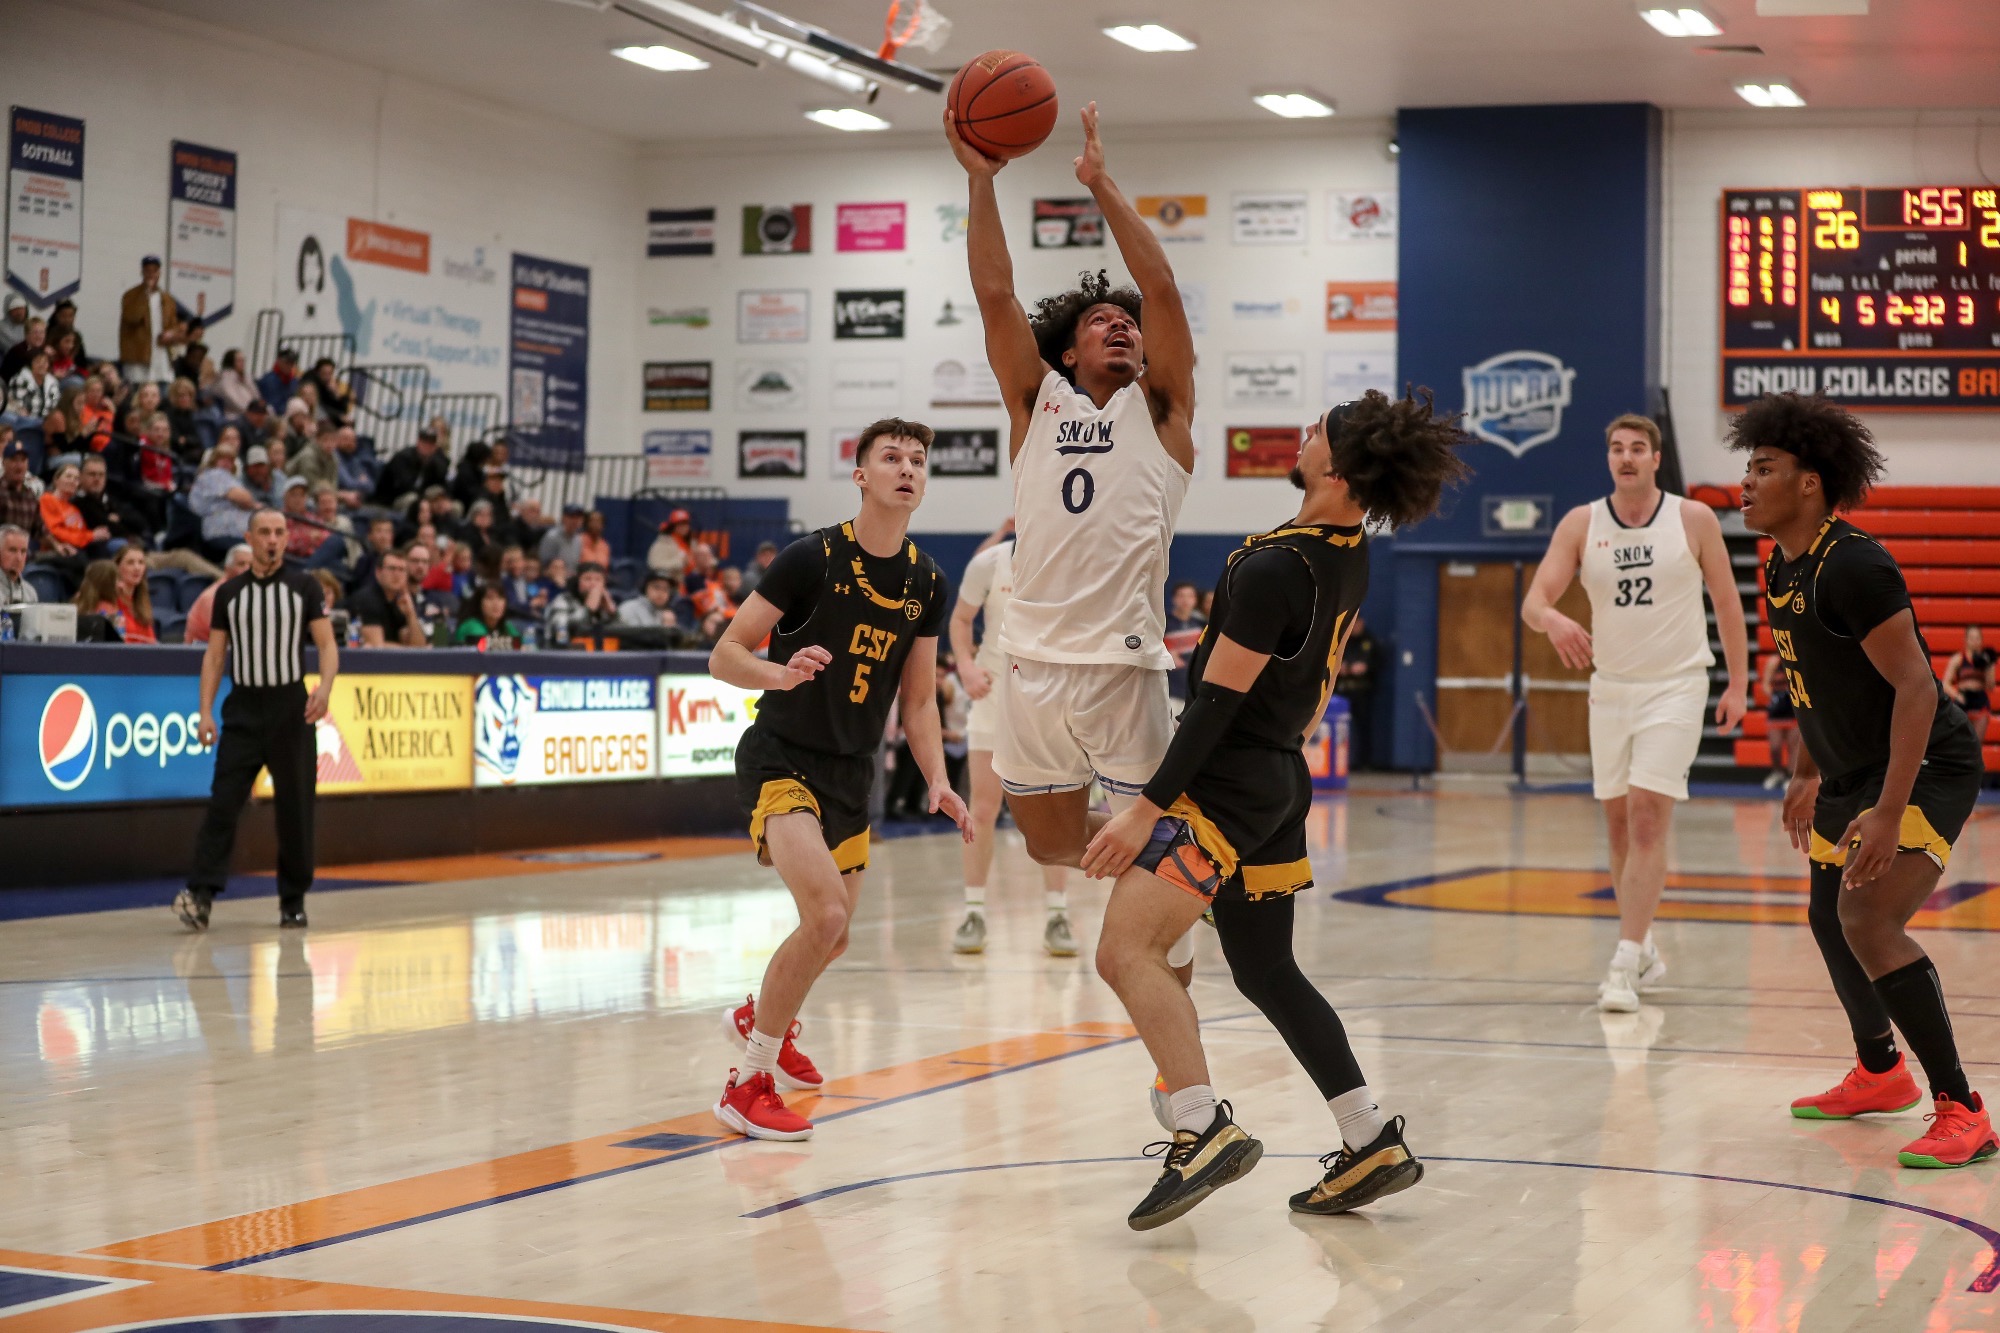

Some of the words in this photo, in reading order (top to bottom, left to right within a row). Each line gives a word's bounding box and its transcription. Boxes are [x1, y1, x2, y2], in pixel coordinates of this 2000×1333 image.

[22, 142, 74, 167] SOFTBALL
[1903, 188, 1963, 226] 1:55
[1815, 211, 1859, 249] 26
[1895, 246, 1937, 267] period
[1820, 296, 1840, 325] 4
[1857, 295, 1876, 326] 5
[1957, 295, 1975, 326] 3
[1733, 366, 1816, 396] SNOW
[1822, 366, 1950, 397] COLLEGE
[1958, 368, 2000, 397] BA
[1056, 420, 1114, 443] SNOW
[1061, 468, 1096, 514] 0
[1614, 545, 1653, 563] SNOW
[1614, 577, 1653, 607] 32
[849, 623, 897, 662] CSI
[1772, 628, 1798, 662] CSI
[849, 664, 871, 704] 5
[354, 686, 463, 721] MOUNTAIN
[105, 712, 212, 769] peps
[362, 726, 454, 760] AMERICA
[544, 734, 648, 775] BADGERS
